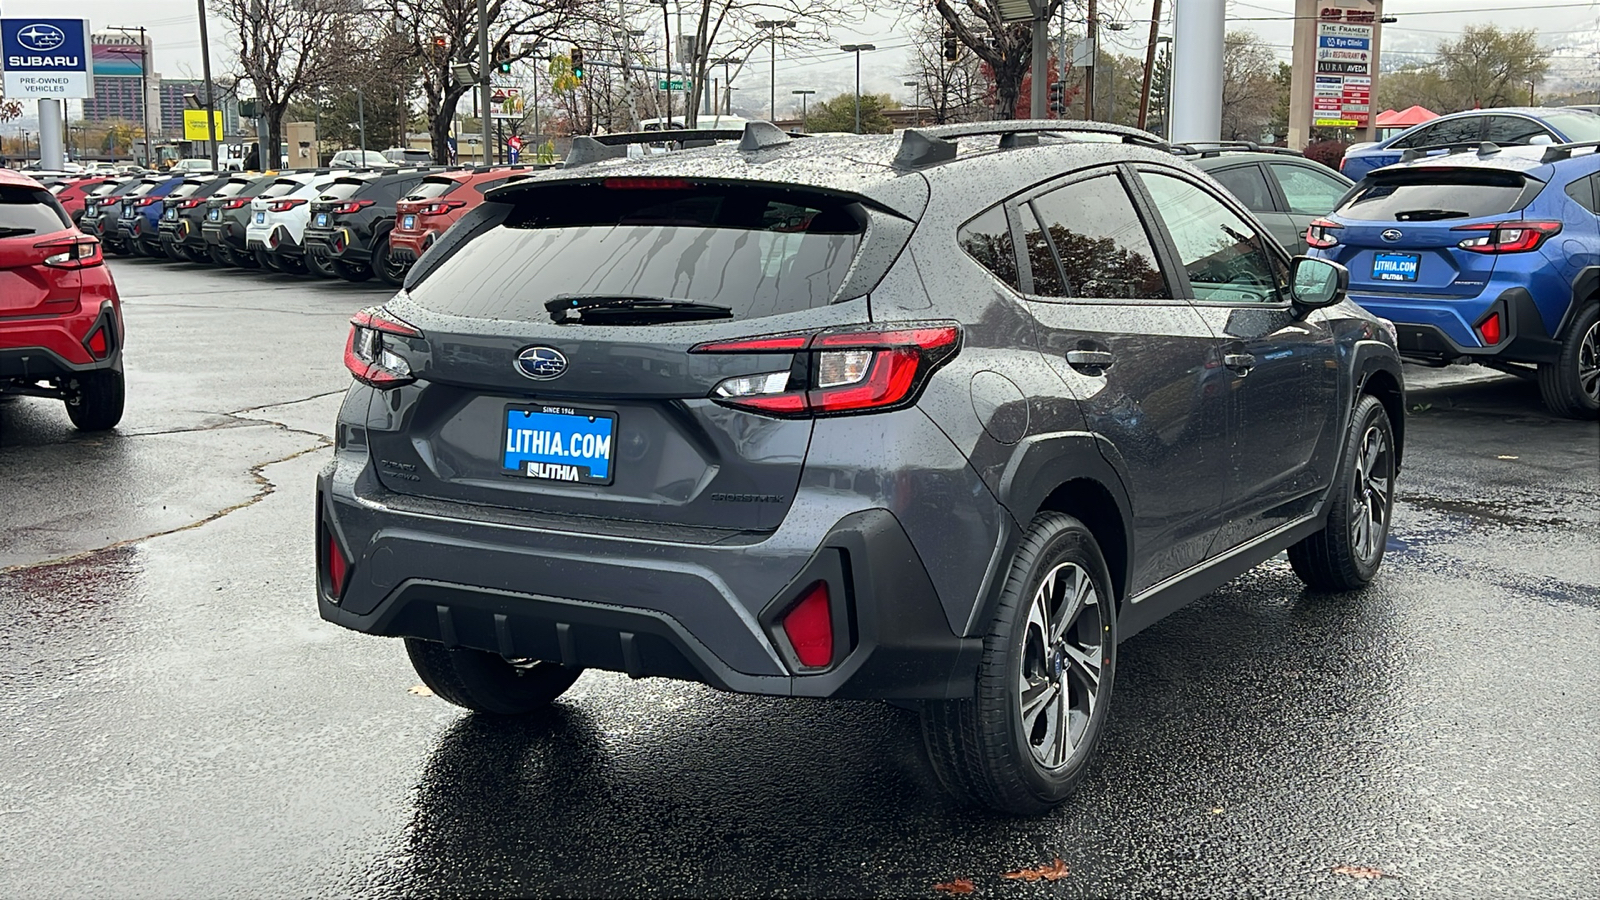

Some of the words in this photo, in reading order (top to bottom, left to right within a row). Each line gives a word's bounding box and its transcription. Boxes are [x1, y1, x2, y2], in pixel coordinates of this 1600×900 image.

[1339, 25, 1370, 34] FRAMERY
[1336, 38, 1347, 47] Eye
[1347, 39, 1363, 47] Clinic
[9, 56, 78, 66] SUBARU
[1319, 62, 1343, 71] AURA
[1346, 64, 1367, 73] AVEDA
[1374, 261, 1417, 272] LITHIA.COM
[542, 406, 560, 414] SINCE
[561, 407, 575, 415] 1946
[506, 428, 612, 460] LITHIA.COM
[538, 463, 580, 482] LITHIA
[711, 493, 785, 503] CROSSTREK
